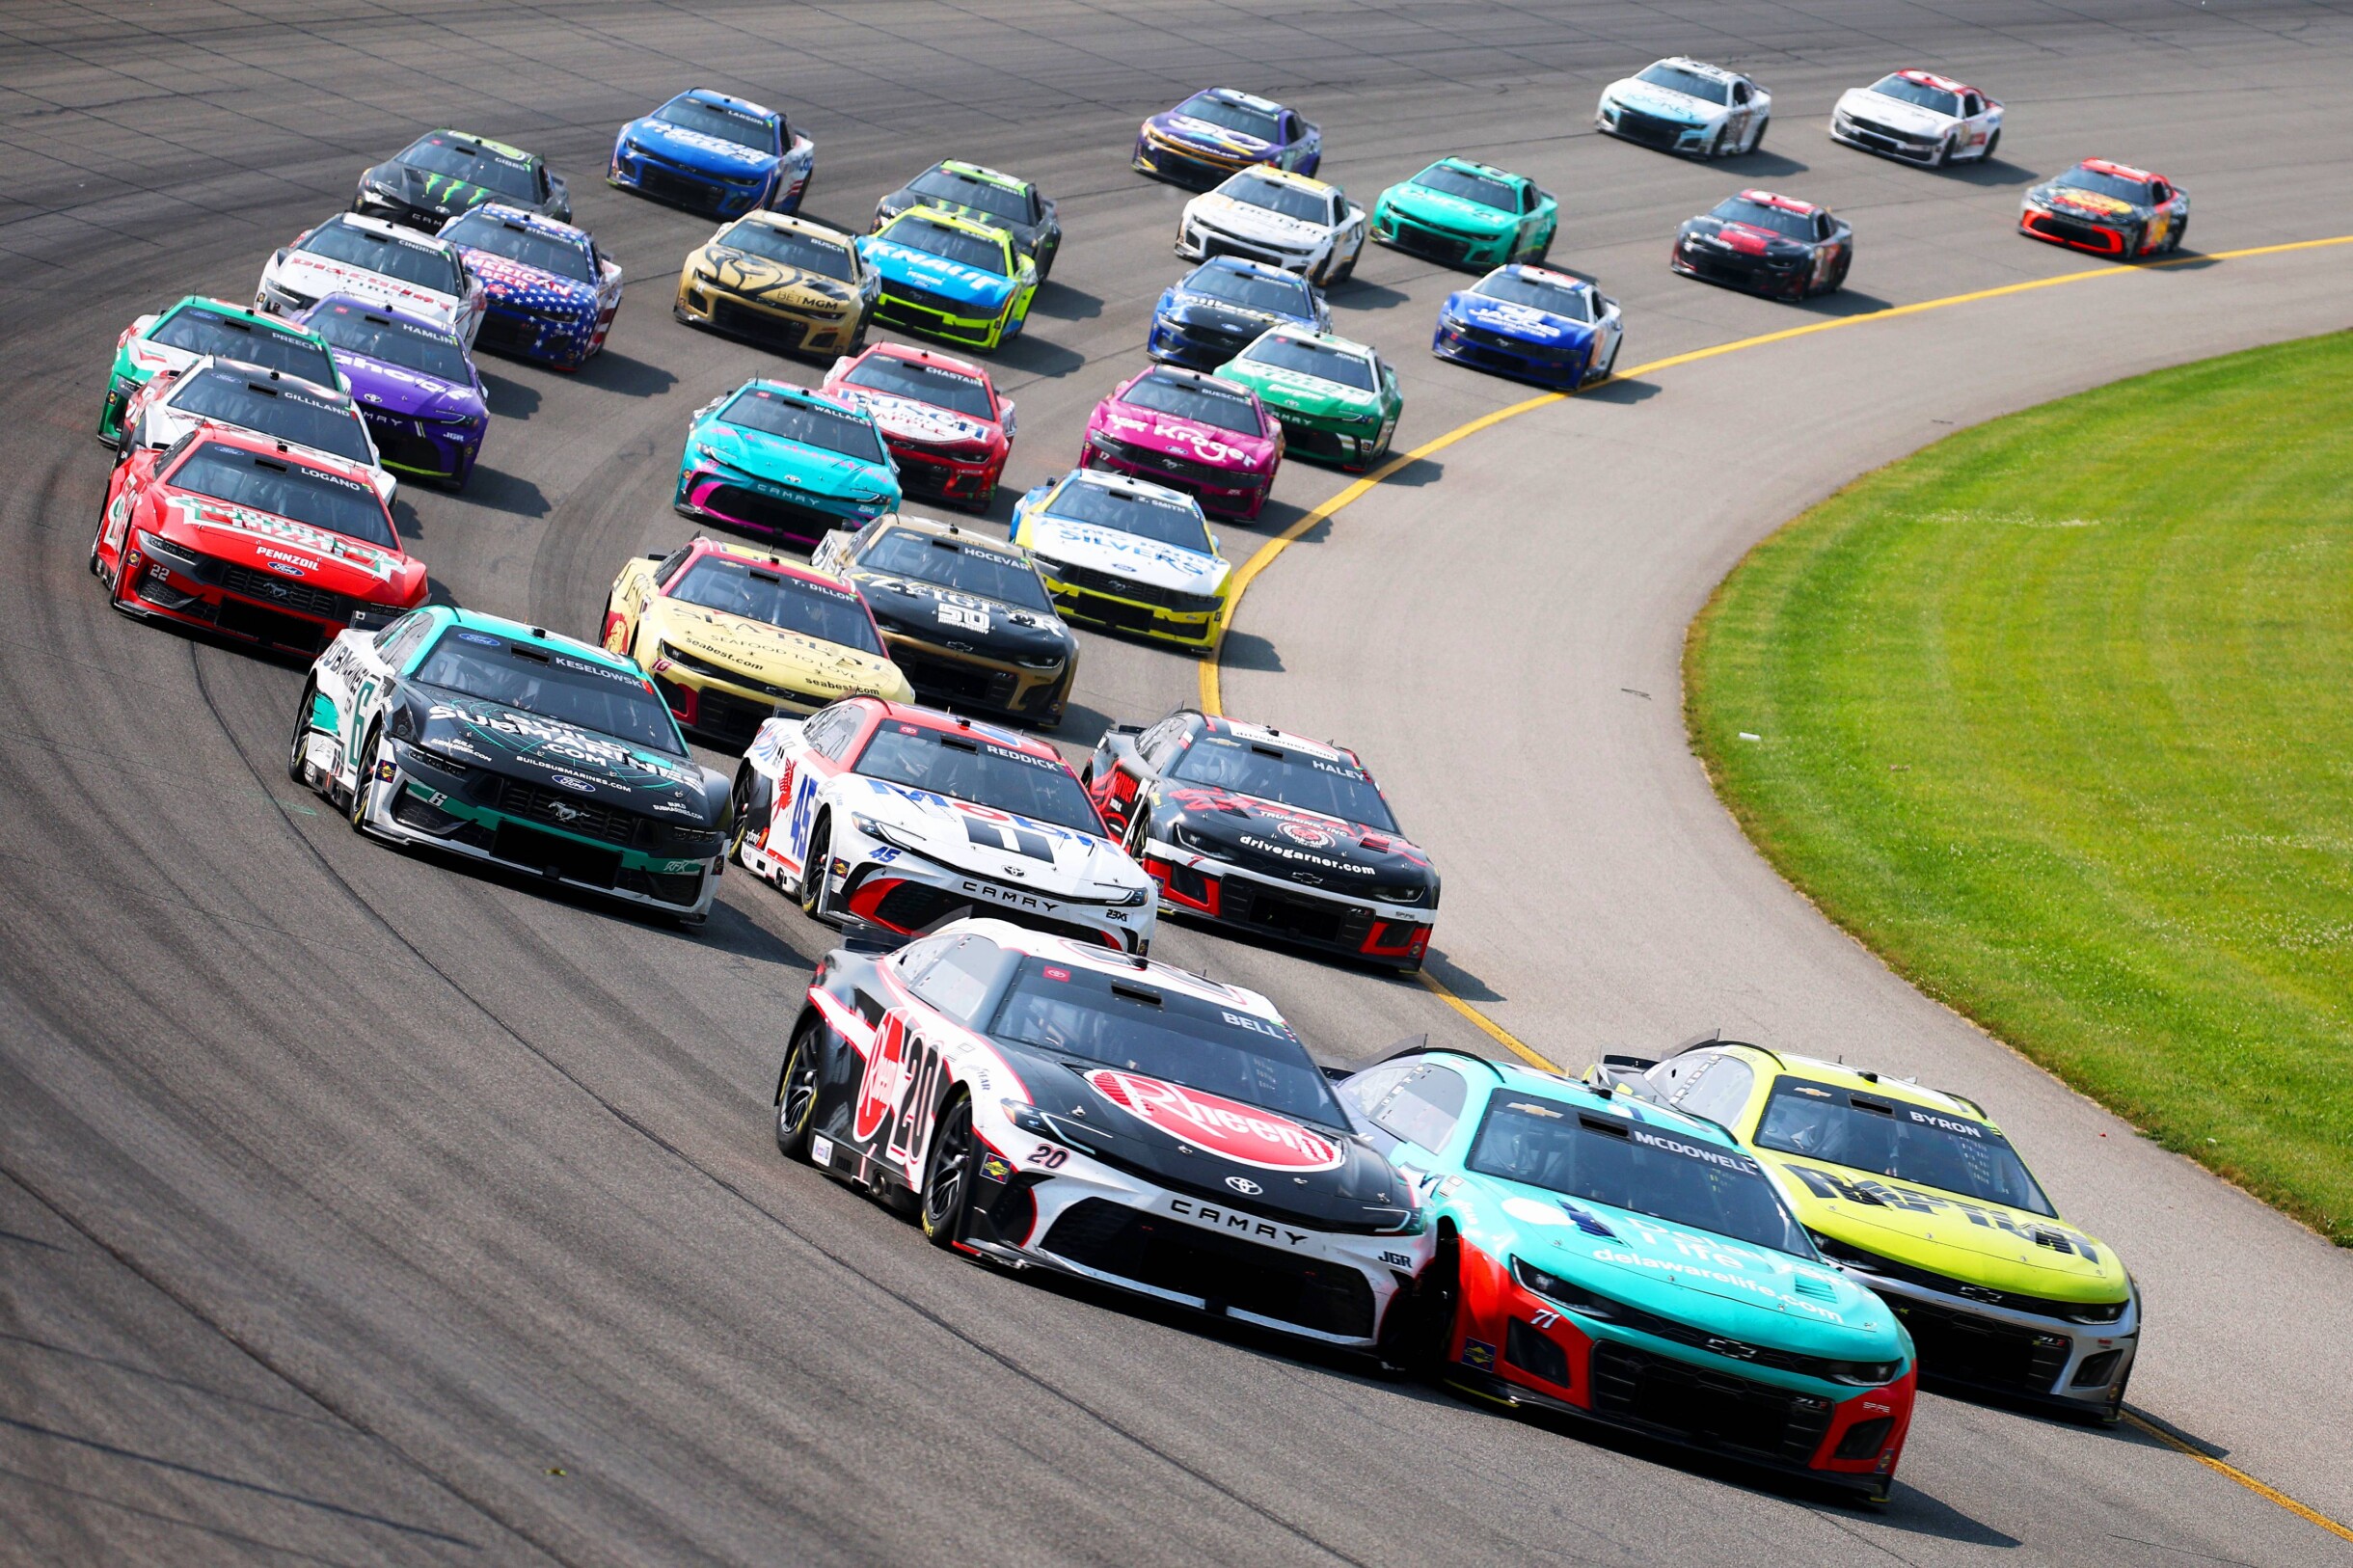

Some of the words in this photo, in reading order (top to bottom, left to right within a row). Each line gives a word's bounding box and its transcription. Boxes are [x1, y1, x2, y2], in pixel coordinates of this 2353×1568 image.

[727, 109, 765, 126] LARSON
[411, 212, 444, 229] CAM
[398, 239, 440, 257] CINDRIC
[810, 237, 846, 254] BUSCH
[861, 240, 1004, 289] KNAUF
[478, 269, 528, 290] BEER
[776, 290, 838, 311] BETMGM
[271, 332, 316, 351] PREECE
[402, 323, 453, 345] HAMLIN
[333, 352, 473, 401] ahoo!
[925, 365, 984, 388] CHASTAIN
[284, 391, 351, 418] GILLILAND
[1201, 388, 1249, 405] BUESCHE
[362, 411, 403, 426] MRY
[814, 404, 867, 425] WALLACE
[1271, 411, 1312, 425] AMRY
[1153, 424, 1258, 468] Kroger
[300, 467, 362, 492] LOGANO
[756, 483, 820, 505] CAMRY
[1150, 500, 1186, 513] SMITH
[256, 546, 320, 572] PENNZOIL
[963, 547, 1030, 572] HOCEVAR
[149, 563, 171, 581] 22
[806, 581, 855, 603] DILLON
[937, 602, 991, 630] 50
[648, 658, 673, 674] 10
[685, 635, 764, 672] seabest.com
[554, 656, 648, 690] KESELOWSKI
[804, 675, 880, 697] seabestcom
[348, 679, 377, 769] 6
[428, 704, 706, 798] SUBMARINES
[541, 743, 608, 768] .COM
[986, 743, 1059, 771] REDDICK
[515, 755, 633, 793] BUILDSUBMARINES.COM
[1312, 759, 1366, 782] HALEY
[428, 791, 447, 807] 6
[789, 773, 820, 862] 45
[987, 823, 1022, 852] 1
[1326, 825, 1350, 838] INC
[868, 845, 903, 864] 45
[1187, 854, 1205, 868] 7
[1239, 834, 1377, 877] drivegarner.com
[961, 880, 1061, 912] CAMRY
[1221, 1011, 1285, 1041] BELL
[889, 1031, 942, 1162] 20
[1112, 1070, 1323, 1162] Rheem
[1908, 1110, 1983, 1139] BYRON
[1026, 1142, 1070, 1171] 20
[1634, 1130, 1756, 1176] MCDOWELL
[1170, 1198, 1309, 1246] CAMRY
[1378, 1250, 1414, 1270] JGR
[1592, 1248, 1844, 1324] delawarelife.com
[1529, 1308, 1562, 1329] 71
